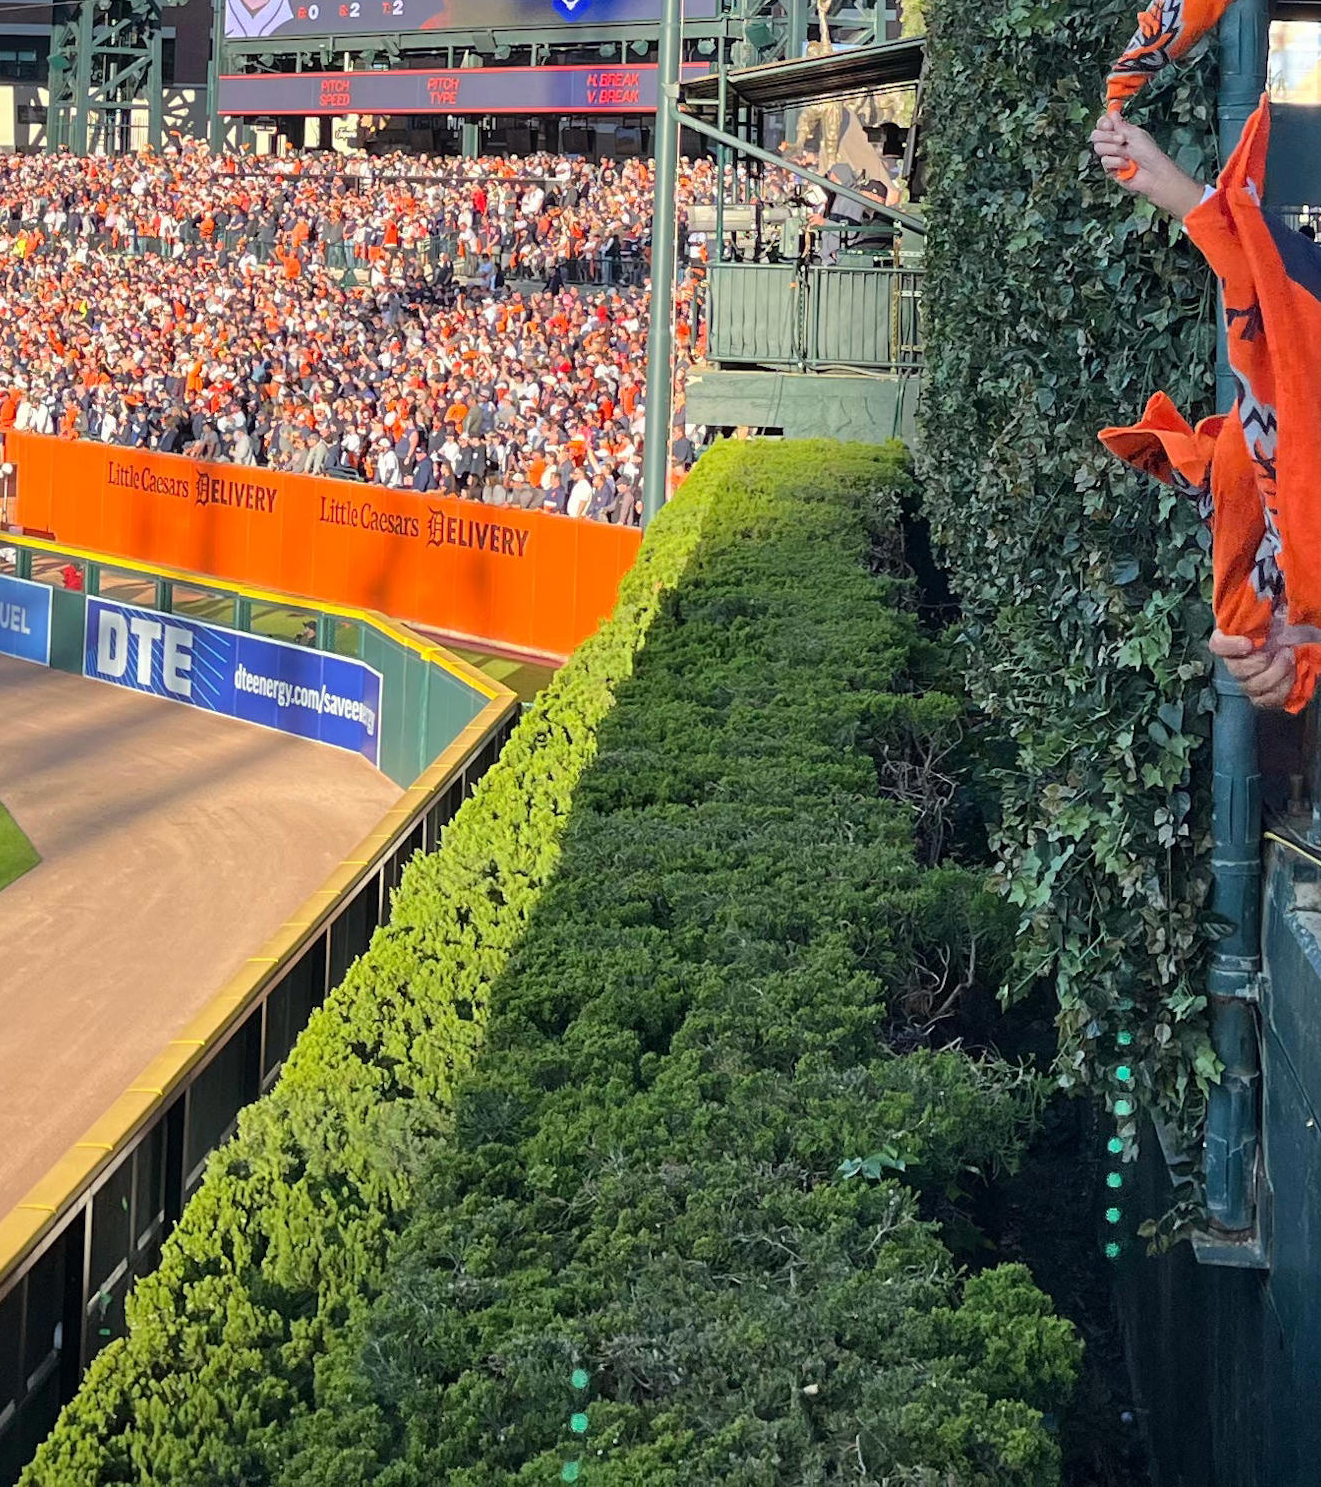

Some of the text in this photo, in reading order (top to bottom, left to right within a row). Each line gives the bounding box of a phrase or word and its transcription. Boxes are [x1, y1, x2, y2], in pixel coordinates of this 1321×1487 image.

[308, 0, 404, 20] 0 2 2
[320, 80, 350, 93] PITCH
[427, 77, 460, 92] PITCH
[600, 72, 640, 87] BREAK
[319, 93, 350, 107] SPEED
[429, 91, 457, 105] TYPE
[599, 89, 640, 103] BREAK
[107, 461, 278, 513] Little Caesars DELIVERY
[319, 496, 530, 558] Little Caesars DELIVERY
[96, 609, 194, 698] DTE
